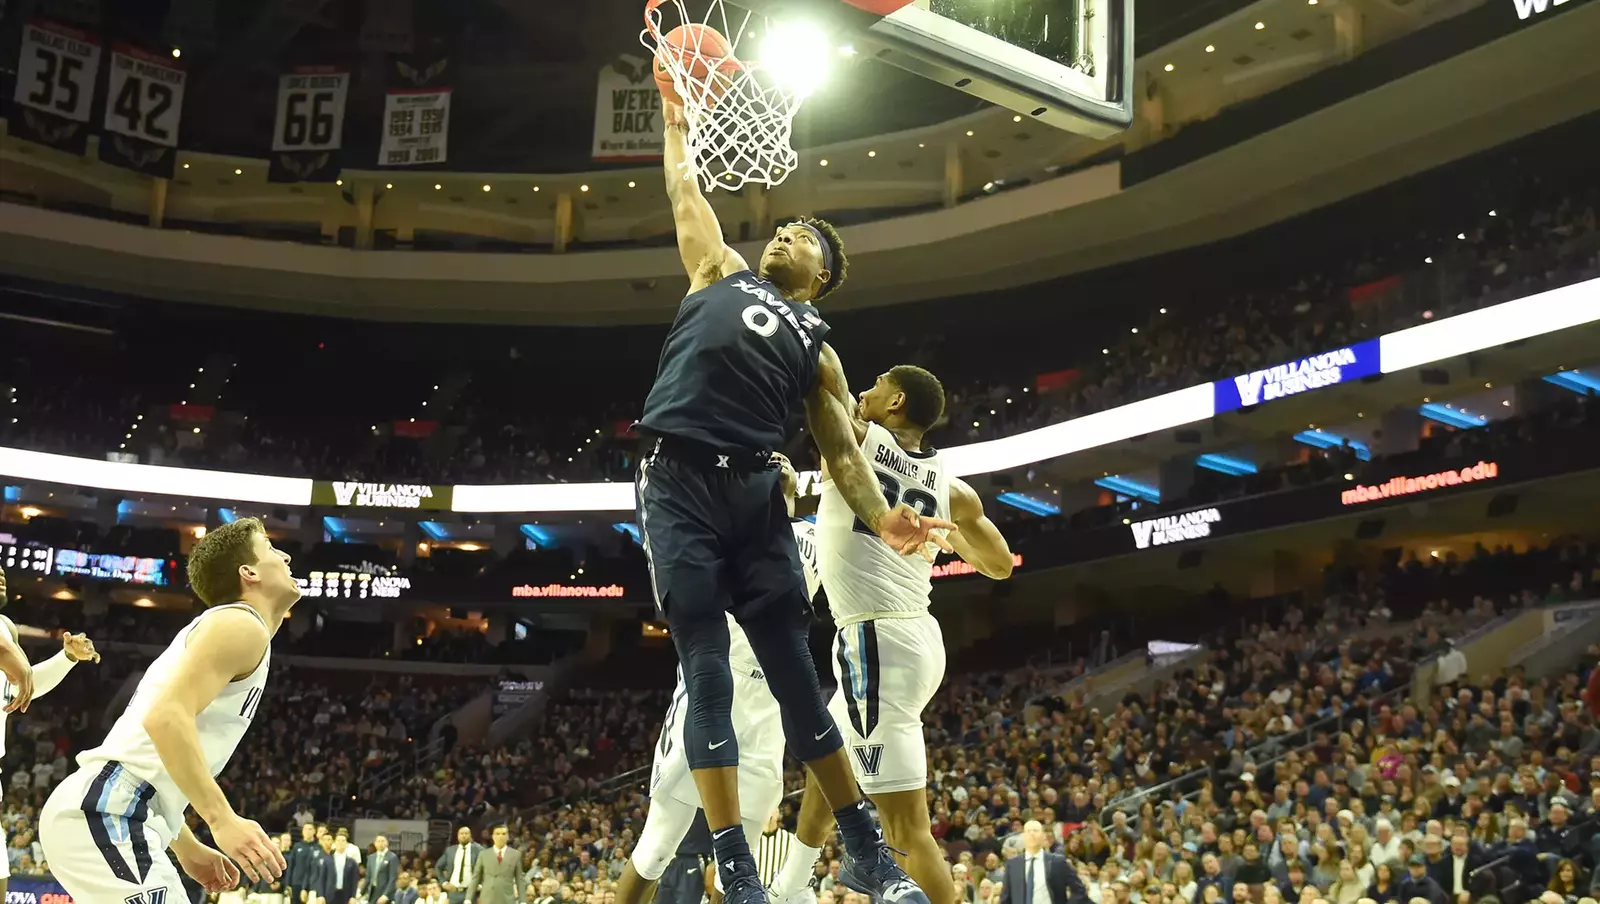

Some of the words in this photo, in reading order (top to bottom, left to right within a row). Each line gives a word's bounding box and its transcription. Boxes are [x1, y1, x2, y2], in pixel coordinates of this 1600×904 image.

[28, 48, 84, 114] 35
[114, 76, 173, 139] 42
[283, 92, 334, 146] 66
[612, 111, 656, 134] BACK
[1263, 347, 1356, 385] VILLANOVA
[1263, 366, 1342, 400] BUSINESS
[715, 454, 730, 468] X
[874, 443, 919, 480] SAMUELS
[921, 469, 937, 492] JR.
[357, 482, 434, 498] VILLANOVA
[1341, 460, 1499, 506] mba.villanova.edu
[356, 493, 421, 508] BUSINESS
[1152, 507, 1221, 532] VILLANOVA
[1152, 522, 1210, 546] BUSINESS
[512, 584, 624, 598] mba.villanova.edu
[853, 744, 885, 777] V
